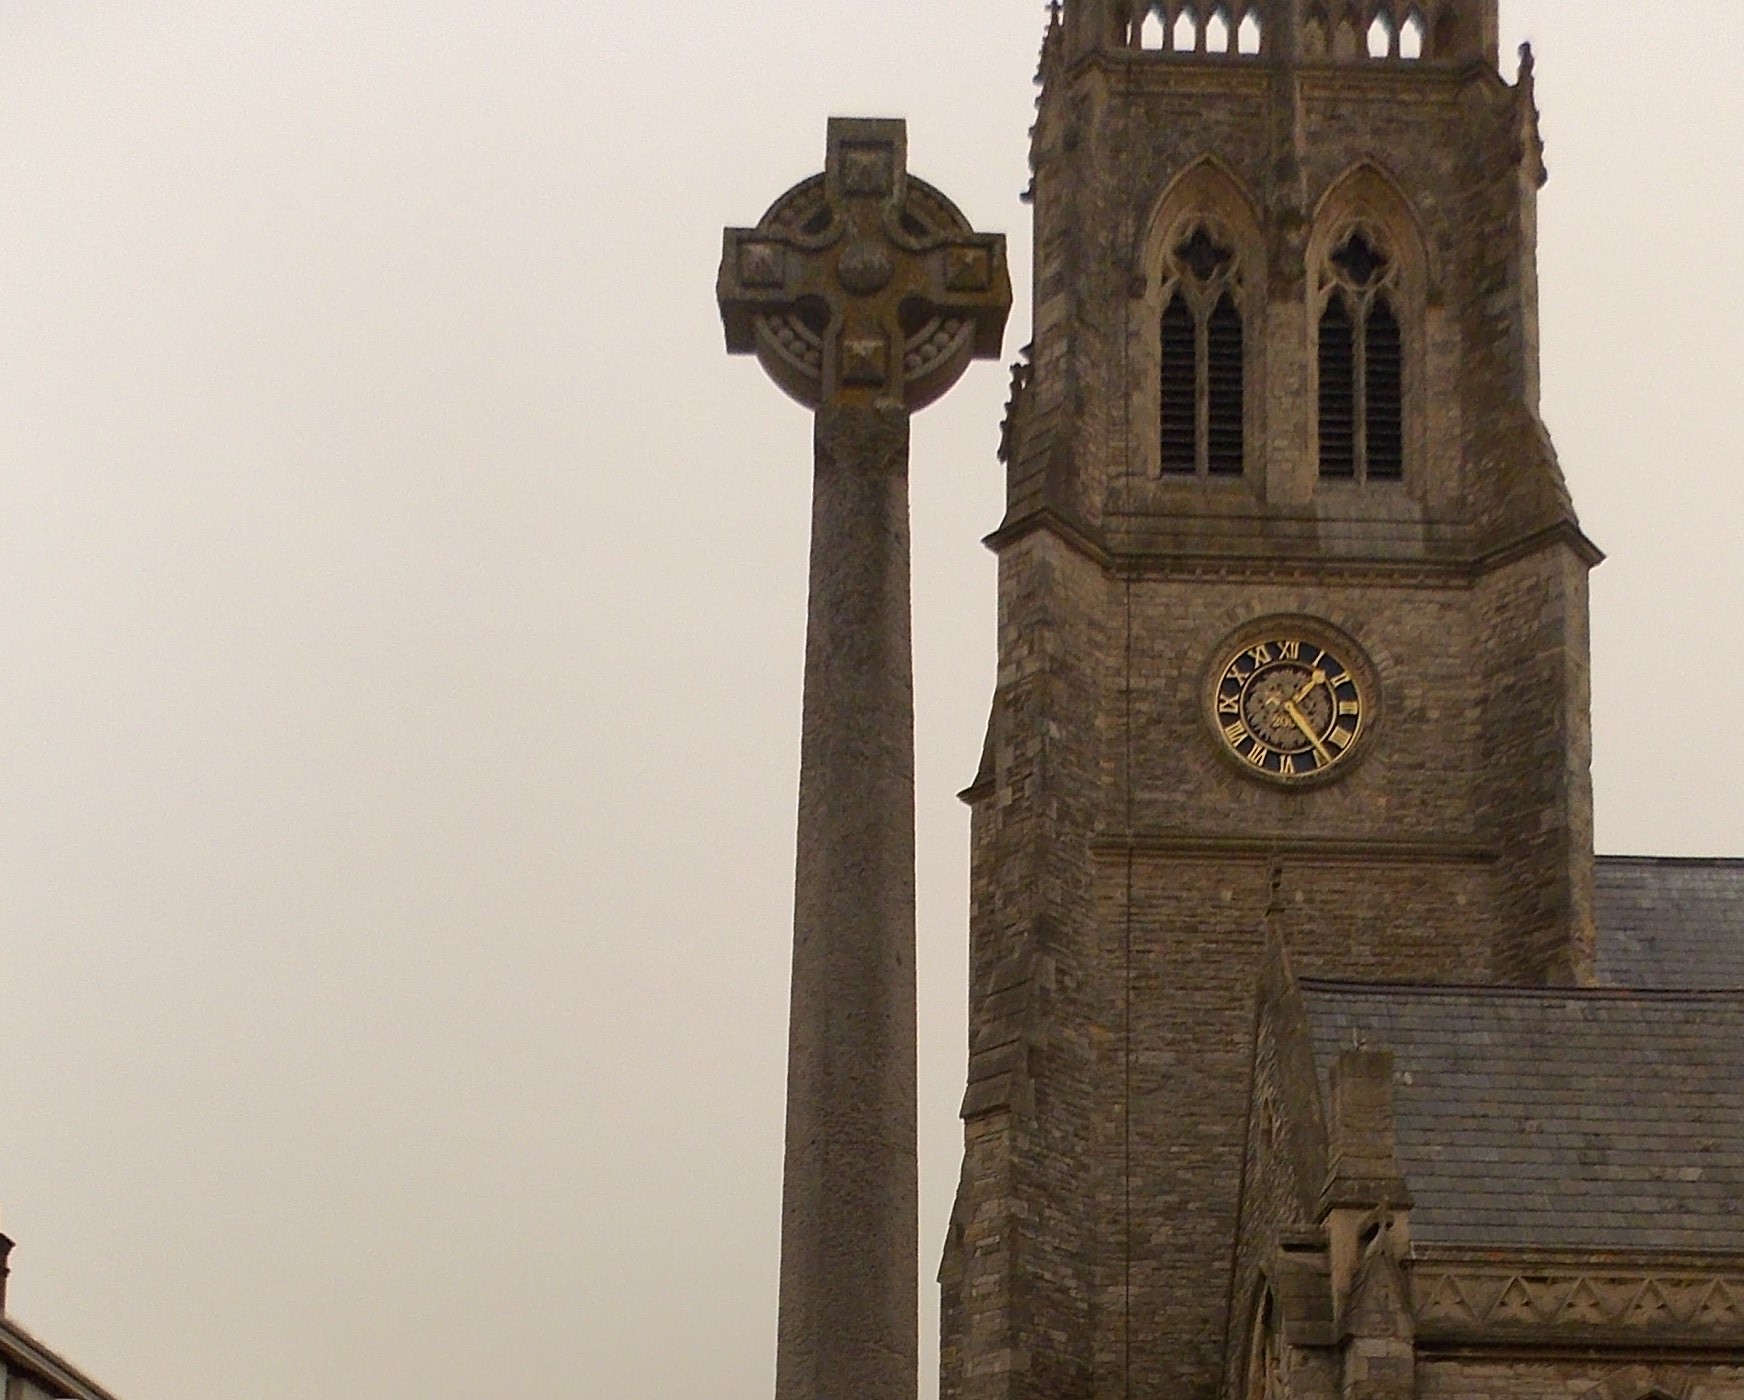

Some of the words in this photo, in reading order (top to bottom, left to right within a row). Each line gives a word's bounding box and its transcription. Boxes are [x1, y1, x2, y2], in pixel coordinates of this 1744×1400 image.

[1247, 645, 1272, 669] XI
[1277, 642, 1300, 660] XII
[1312, 650, 1325, 667] I
[1227, 665, 1250, 687] X
[1330, 673, 1351, 688] II
[1219, 694, 1239, 714] IX
[1226, 720, 1248, 747] VIII
[1247, 743, 1268, 767] VII
[1279, 754, 1295, 774] VI
